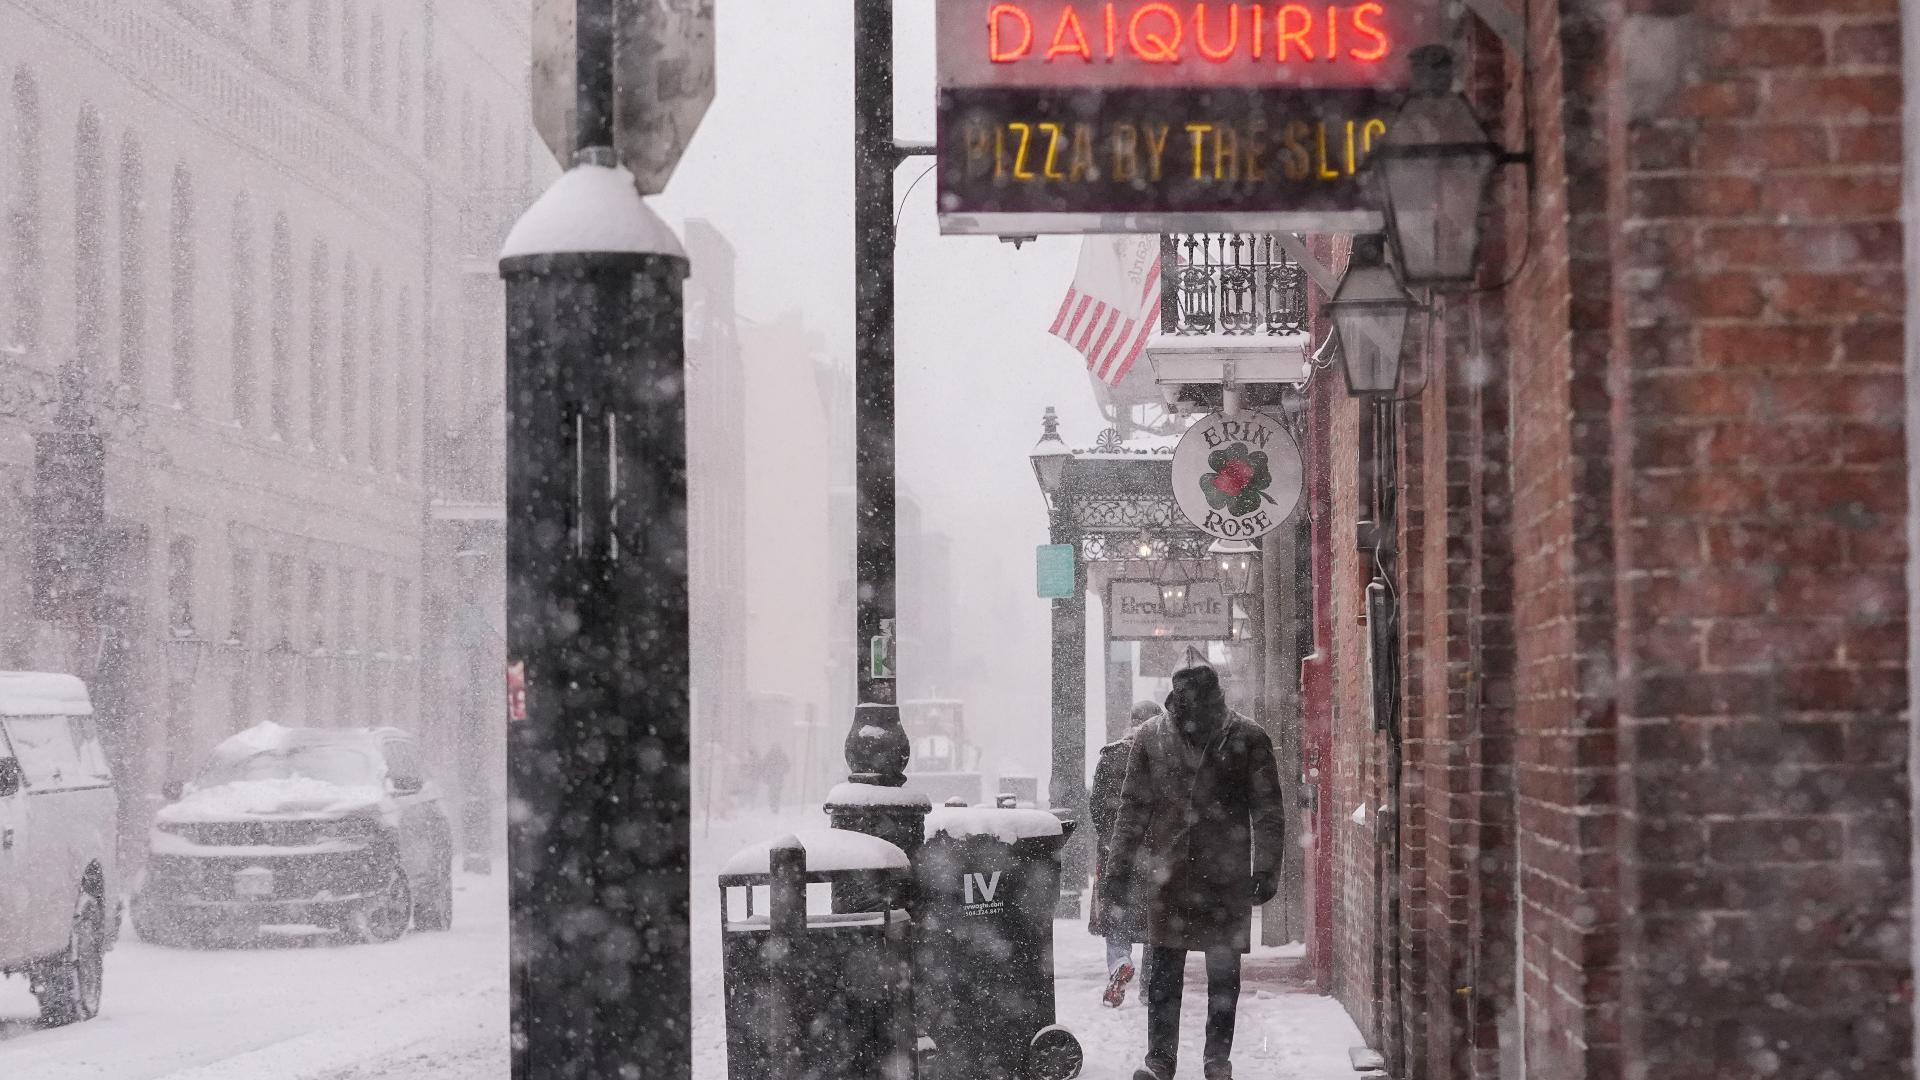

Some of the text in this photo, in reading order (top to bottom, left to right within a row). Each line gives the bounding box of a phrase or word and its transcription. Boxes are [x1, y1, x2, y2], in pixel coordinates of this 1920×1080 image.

[987, 2, 1390, 63] DAIQUIRIS
[965, 120, 1096, 181] PIZZA
[1112, 120, 1170, 182] BY
[1184, 121, 1266, 181] THE
[1201, 420, 1273, 449] ERIN
[1203, 510, 1272, 537] ROSE
[964, 871, 1002, 903] IV
